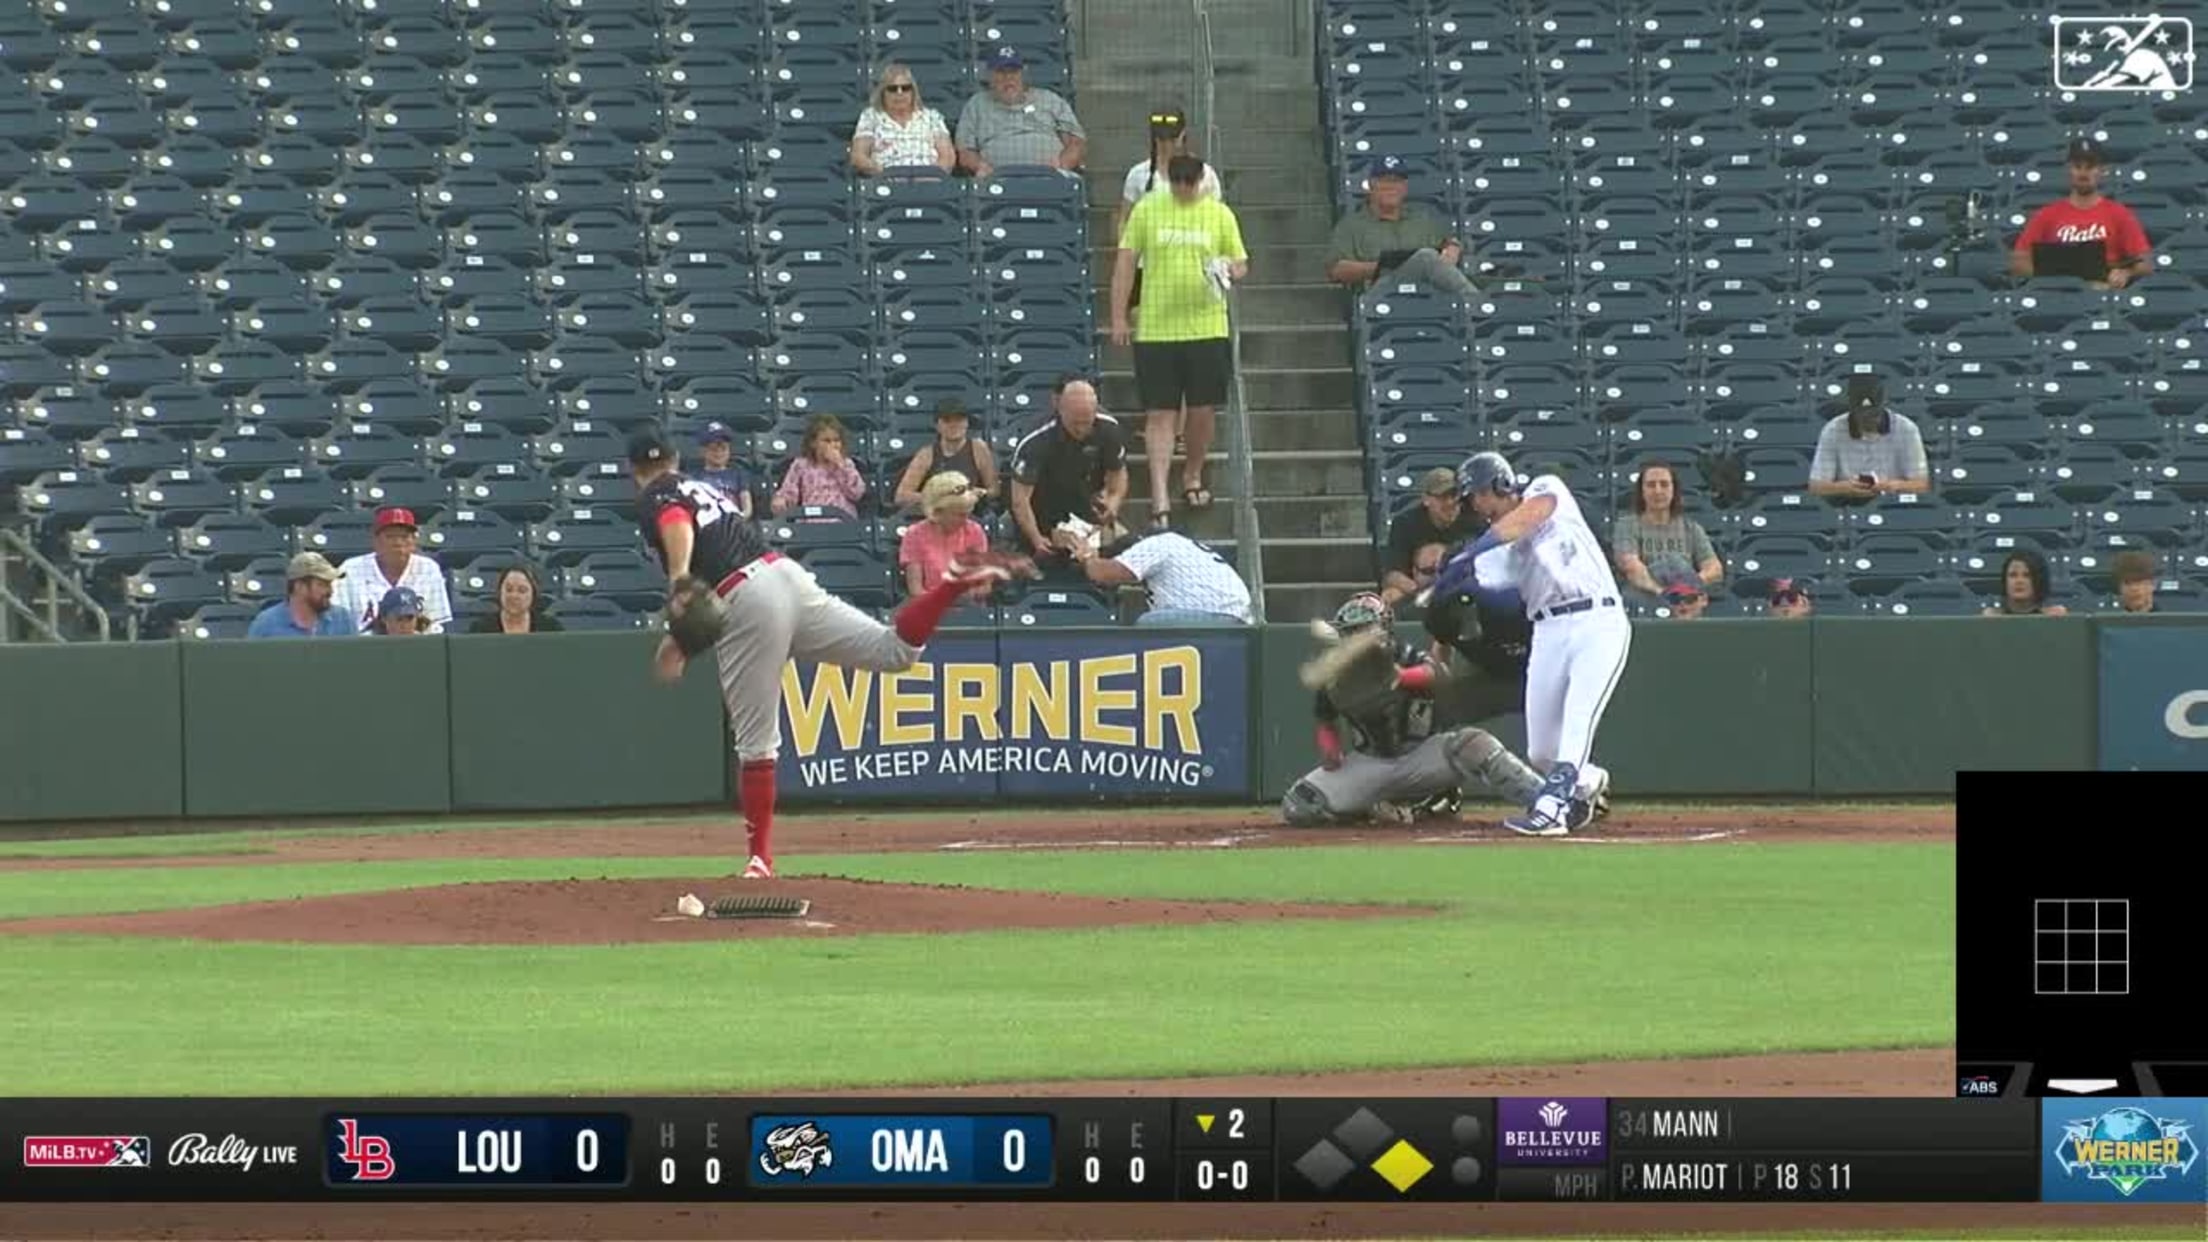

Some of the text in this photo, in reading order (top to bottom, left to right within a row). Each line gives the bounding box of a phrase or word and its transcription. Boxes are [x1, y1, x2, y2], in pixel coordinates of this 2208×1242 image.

[2056, 223, 2107, 242] Bats
[781, 645, 1203, 756] WERNER
[800, 762, 847, 788] WE
[856, 750, 930, 781] KEEP
[938, 746, 1073, 774] AMERICA
